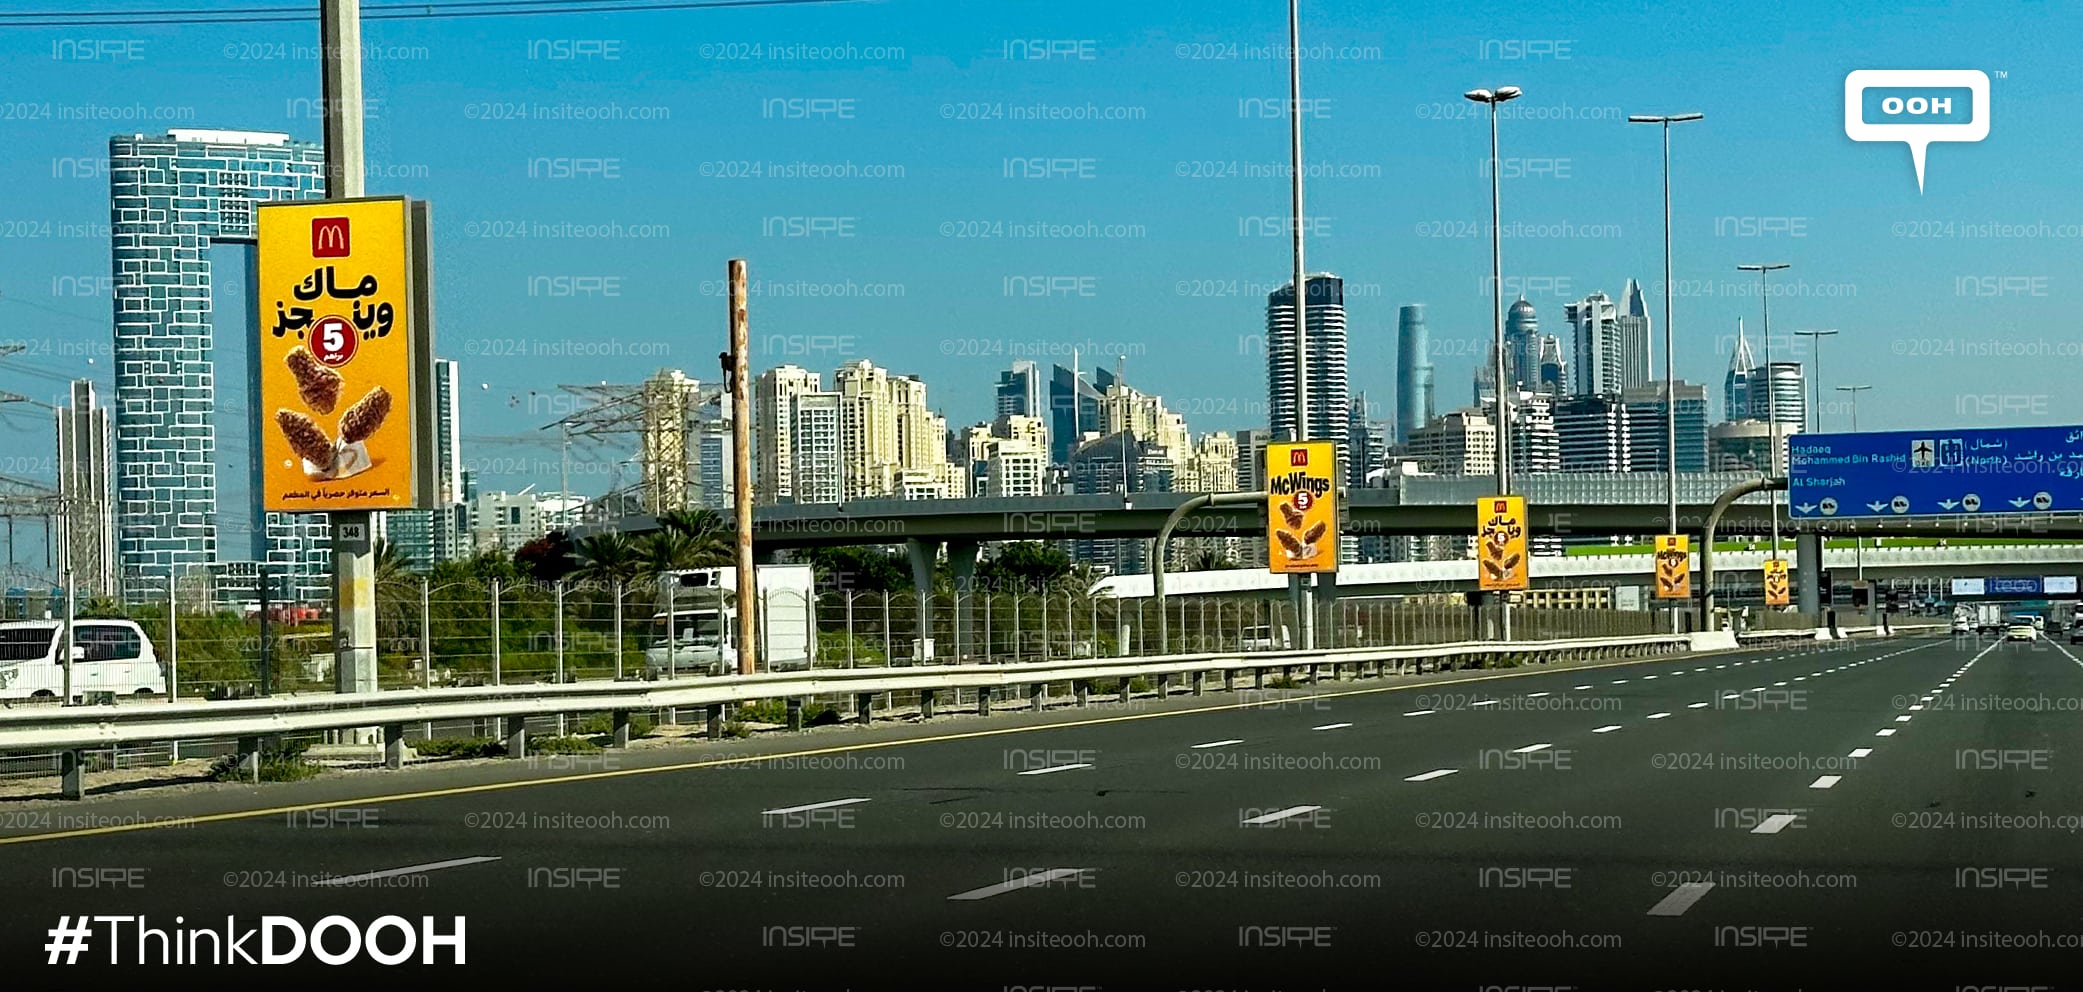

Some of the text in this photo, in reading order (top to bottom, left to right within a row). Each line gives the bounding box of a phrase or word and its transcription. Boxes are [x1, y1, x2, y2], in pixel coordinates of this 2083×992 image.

[293, 266, 378, 301] ماك
[323, 323, 345, 352] 5
[1792, 455, 1850, 465] Mohammed
[1852, 454, 1869, 463] Bin
[1871, 453, 1906, 463] Rashid
[1270, 471, 1330, 499] McWings
[1297, 492, 1309, 506] 5
[343, 526, 360, 538] 348
